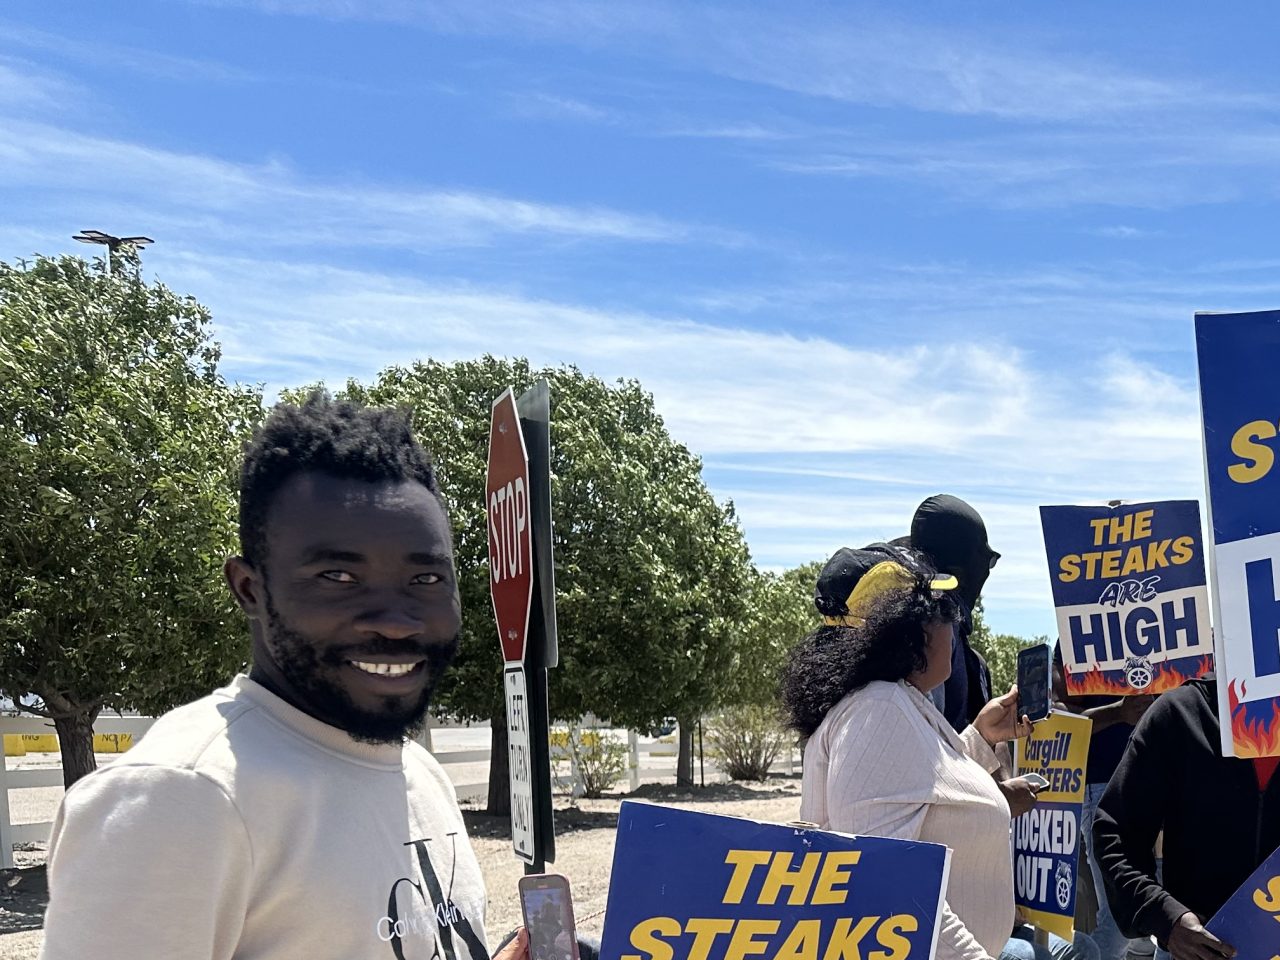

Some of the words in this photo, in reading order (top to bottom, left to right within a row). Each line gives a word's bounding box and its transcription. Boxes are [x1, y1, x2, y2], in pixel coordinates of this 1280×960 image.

[490, 476, 526, 584] STOP
[1090, 509, 1154, 546] THE
[1058, 536, 1195, 582] STEAKS
[1099, 575, 1161, 607] ARE
[1069, 596, 1200, 664] HIGH
[508, 694, 526, 735] LEFT
[510, 743, 528, 782] TURN
[1024, 731, 1072, 767] Cargill
[513, 792, 530, 832] ONLY
[1016, 808, 1077, 855] LOCKED
[722, 849, 862, 906] THE
[1017, 856, 1053, 903] OUT
[435, 902, 465, 927] Klein
